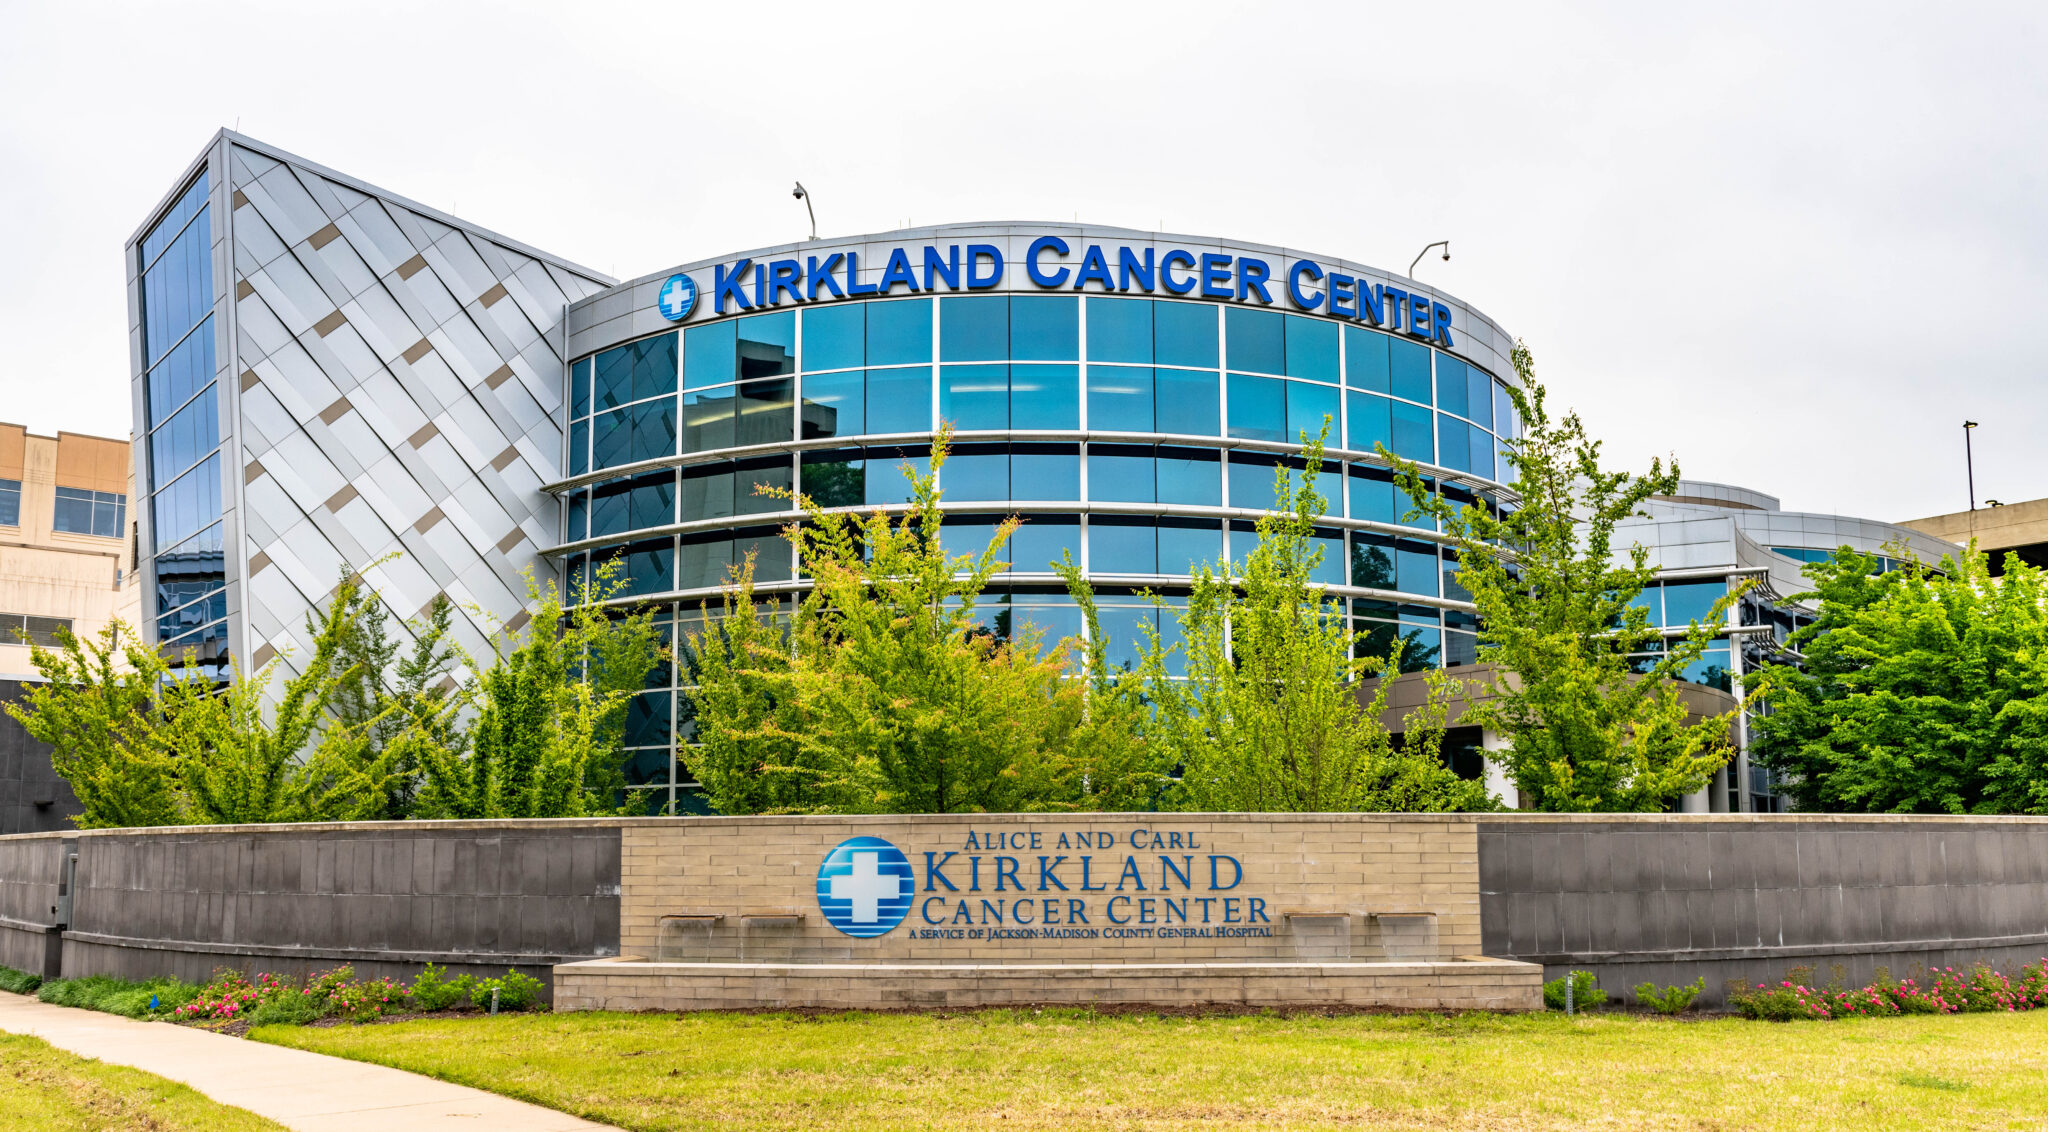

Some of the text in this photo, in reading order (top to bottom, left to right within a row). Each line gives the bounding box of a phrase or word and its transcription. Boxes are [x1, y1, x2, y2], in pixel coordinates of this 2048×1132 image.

[714, 235, 1455, 347] KIRKLAND CANCER CENTER
[964, 829, 1200, 850] ALICE AND CARL
[923, 851, 1243, 892] KIRKLAND
[922, 895, 1271, 925] CANCER CENTER
[909, 926, 1273, 942] A SERVICE OF JACKSON-MADISON COUNTY GENERAL HOSPITAL
